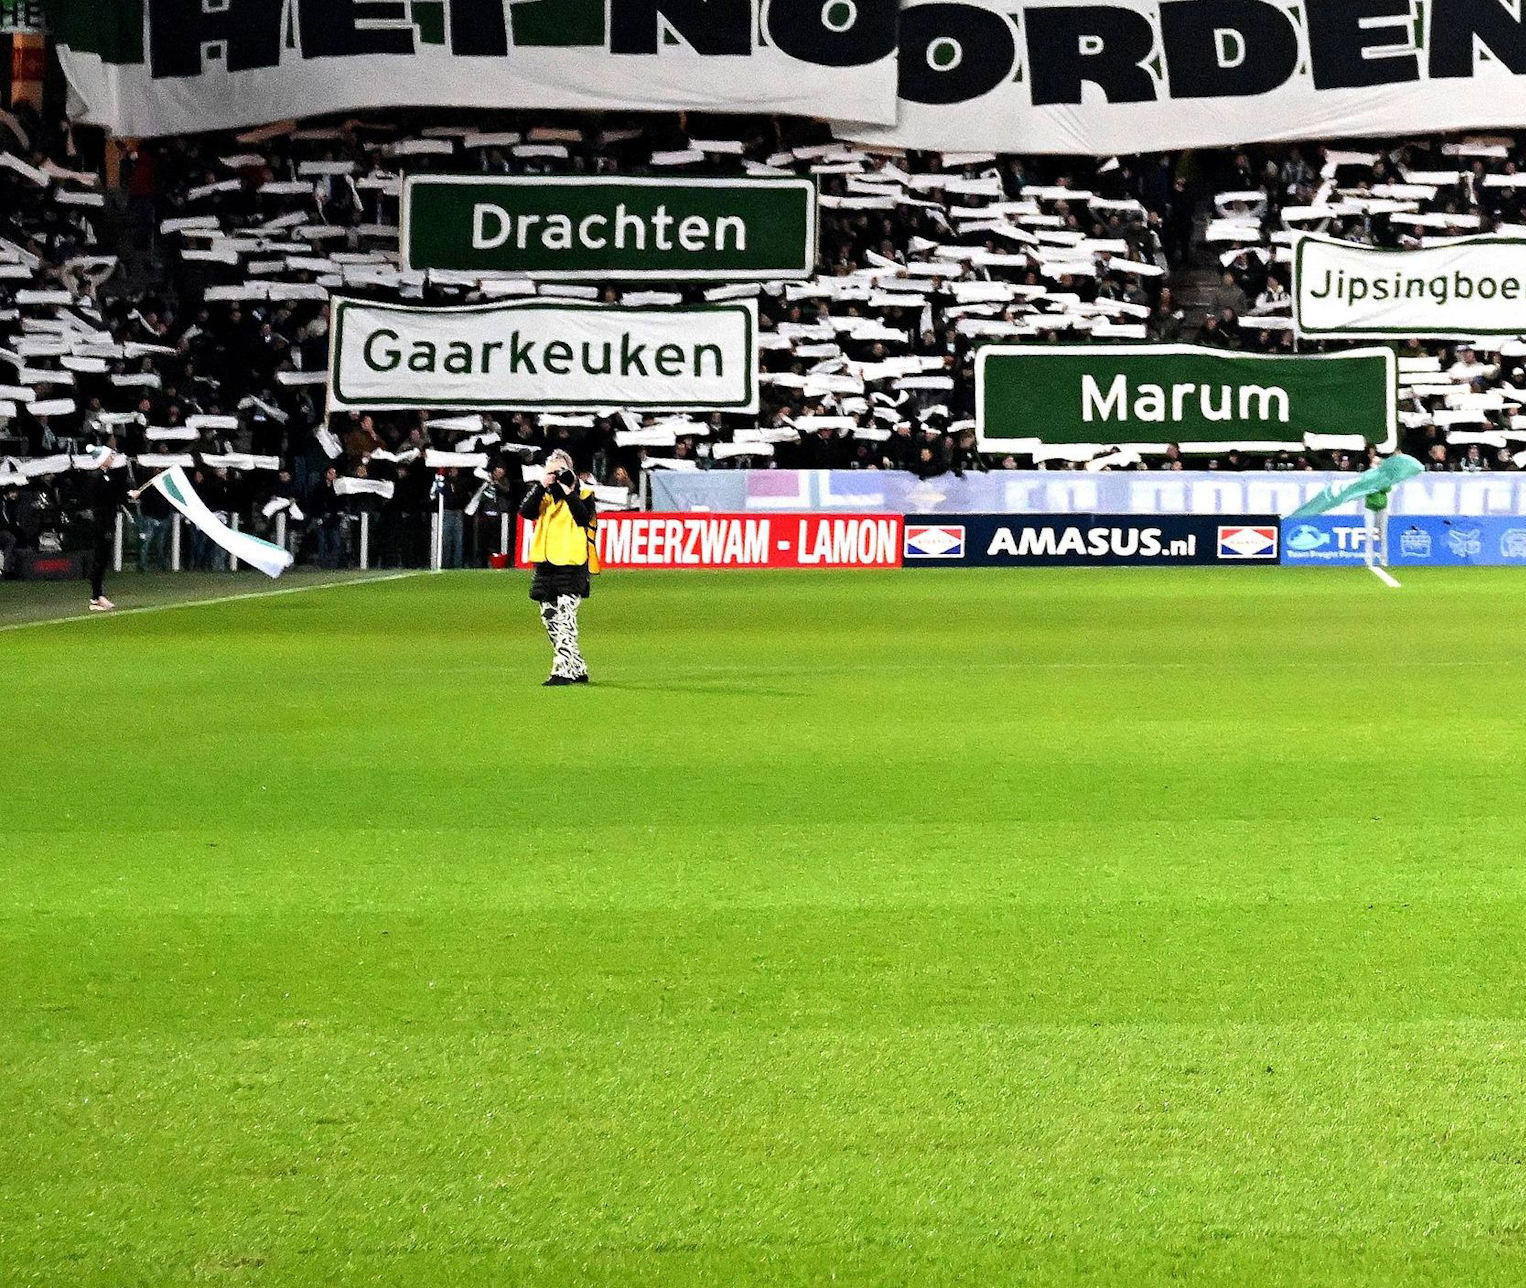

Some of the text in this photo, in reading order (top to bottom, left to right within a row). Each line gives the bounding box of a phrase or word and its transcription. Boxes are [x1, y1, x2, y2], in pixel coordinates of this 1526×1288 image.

[471, 202, 746, 252] Drachten
[363, 328, 724, 377] Gaarkeuken
[1080, 373, 1291, 422] Marum
[796, 518, 897, 564] LAMON
[986, 526, 1197, 557] AMASUS.nl
